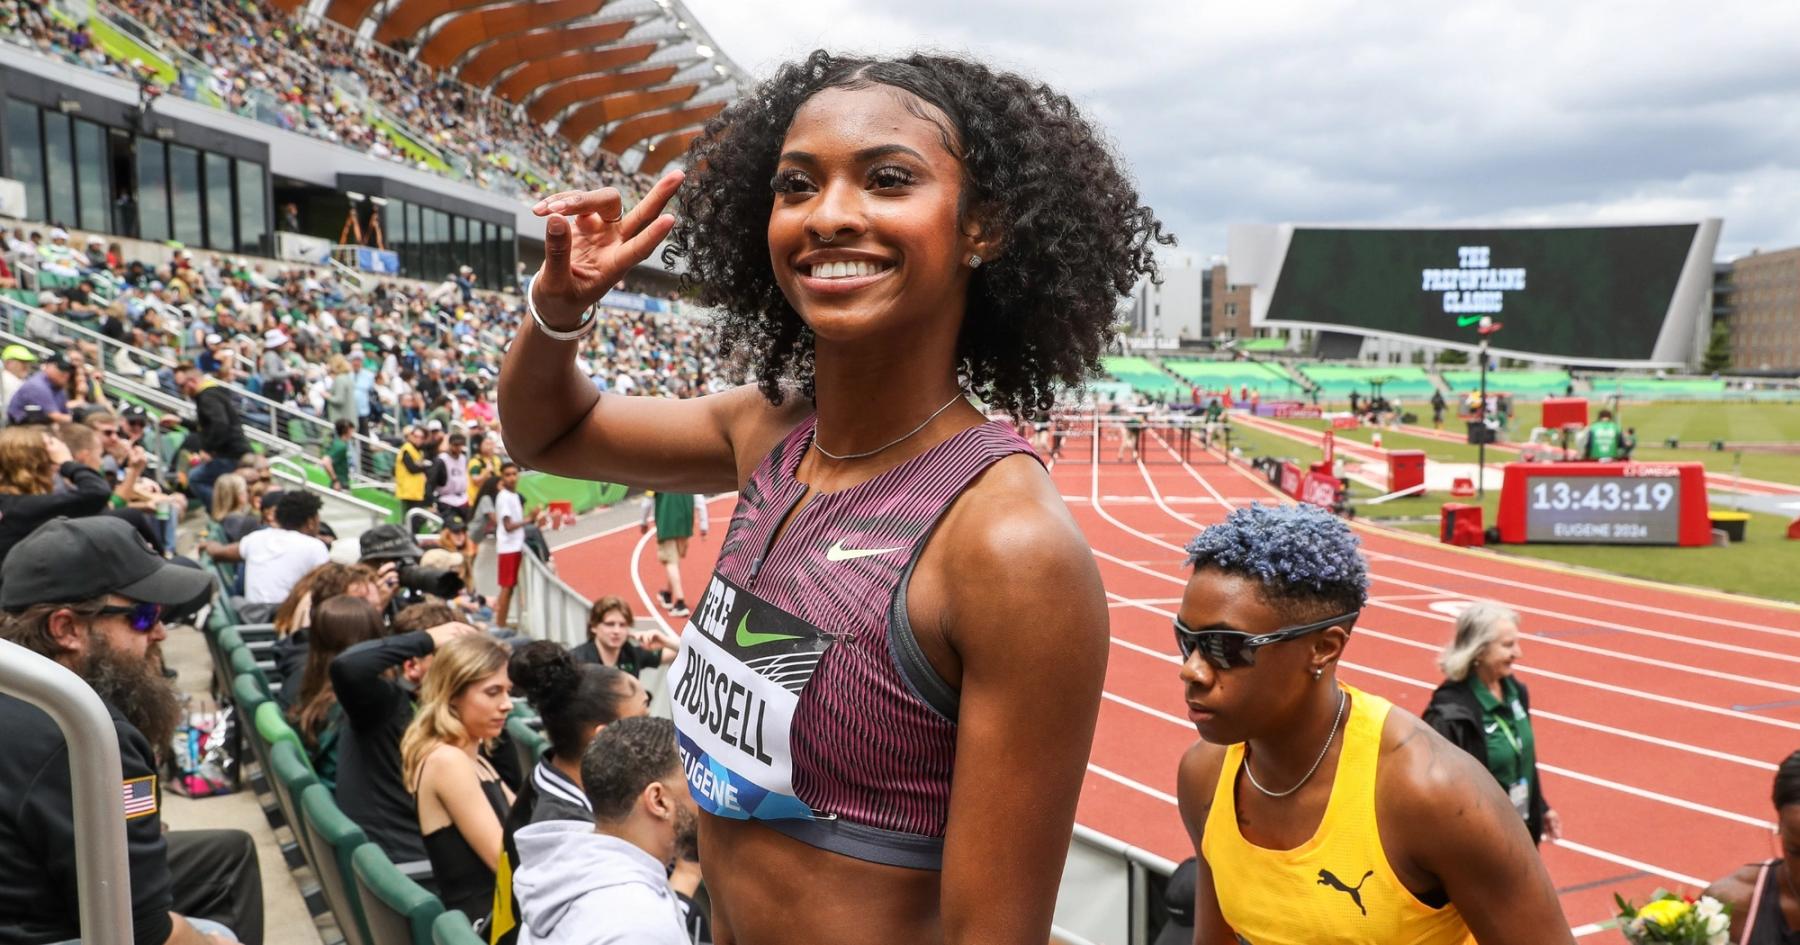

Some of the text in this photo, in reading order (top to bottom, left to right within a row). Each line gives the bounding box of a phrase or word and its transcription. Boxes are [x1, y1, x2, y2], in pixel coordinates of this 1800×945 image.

[1458, 246, 1490, 268] THE
[1533, 482, 1674, 510] 13:43:19
[1554, 523, 1648, 538] EUGENE 2024
[698, 575, 737, 642] PRE
[673, 645, 772, 767] RUSSELL
